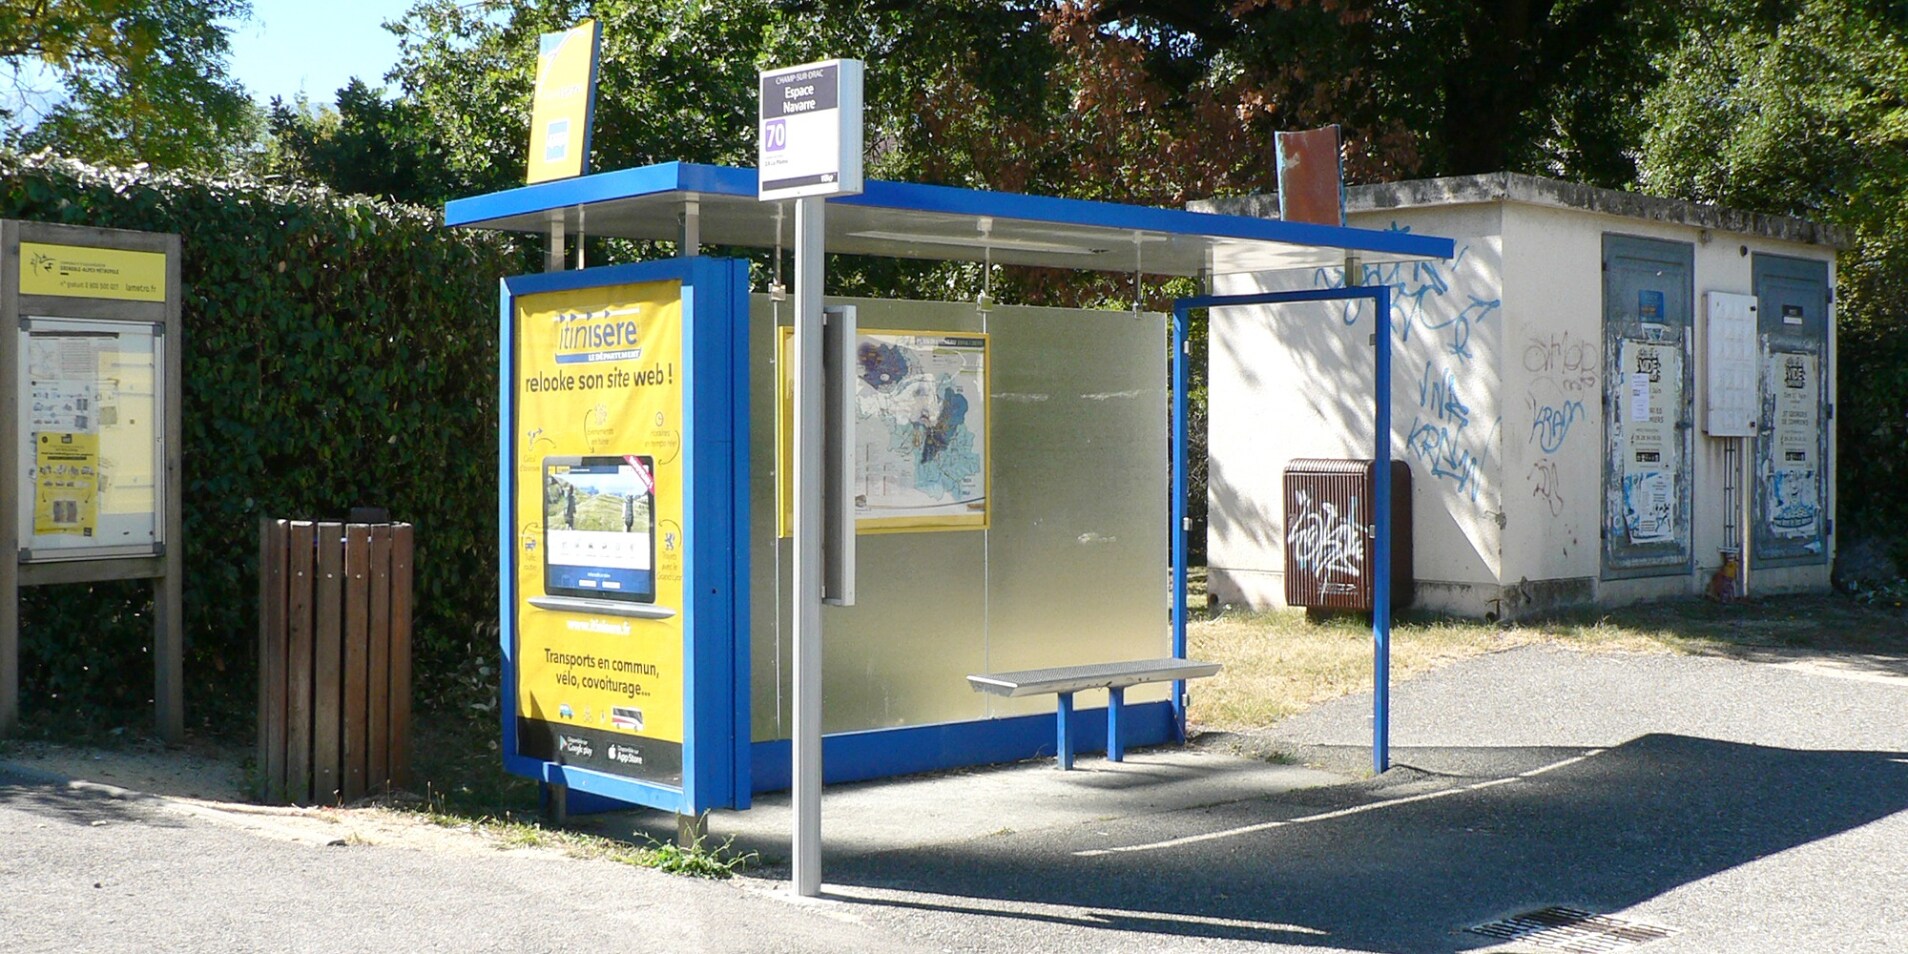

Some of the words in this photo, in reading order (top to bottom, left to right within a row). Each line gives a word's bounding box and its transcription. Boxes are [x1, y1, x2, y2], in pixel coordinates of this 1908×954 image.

[775, 70, 824, 84] CHAMP-SUR-DRAC
[784, 85, 814, 100] Espace
[783, 100, 816, 113] Navarre
[766, 123, 785, 148] 70
[526, 369, 575, 392] relooke
[578, 374, 604, 390] son
[607, 367, 630, 388] site
[633, 362, 664, 386] web
[668, 362, 673, 385] !
[544, 648, 596, 670] Transports
[597, 659, 610, 670] en
[612, 660, 659, 679] commun,
[556, 670, 580, 689] vélo,
[582, 675, 651, 699] covoiturage...
